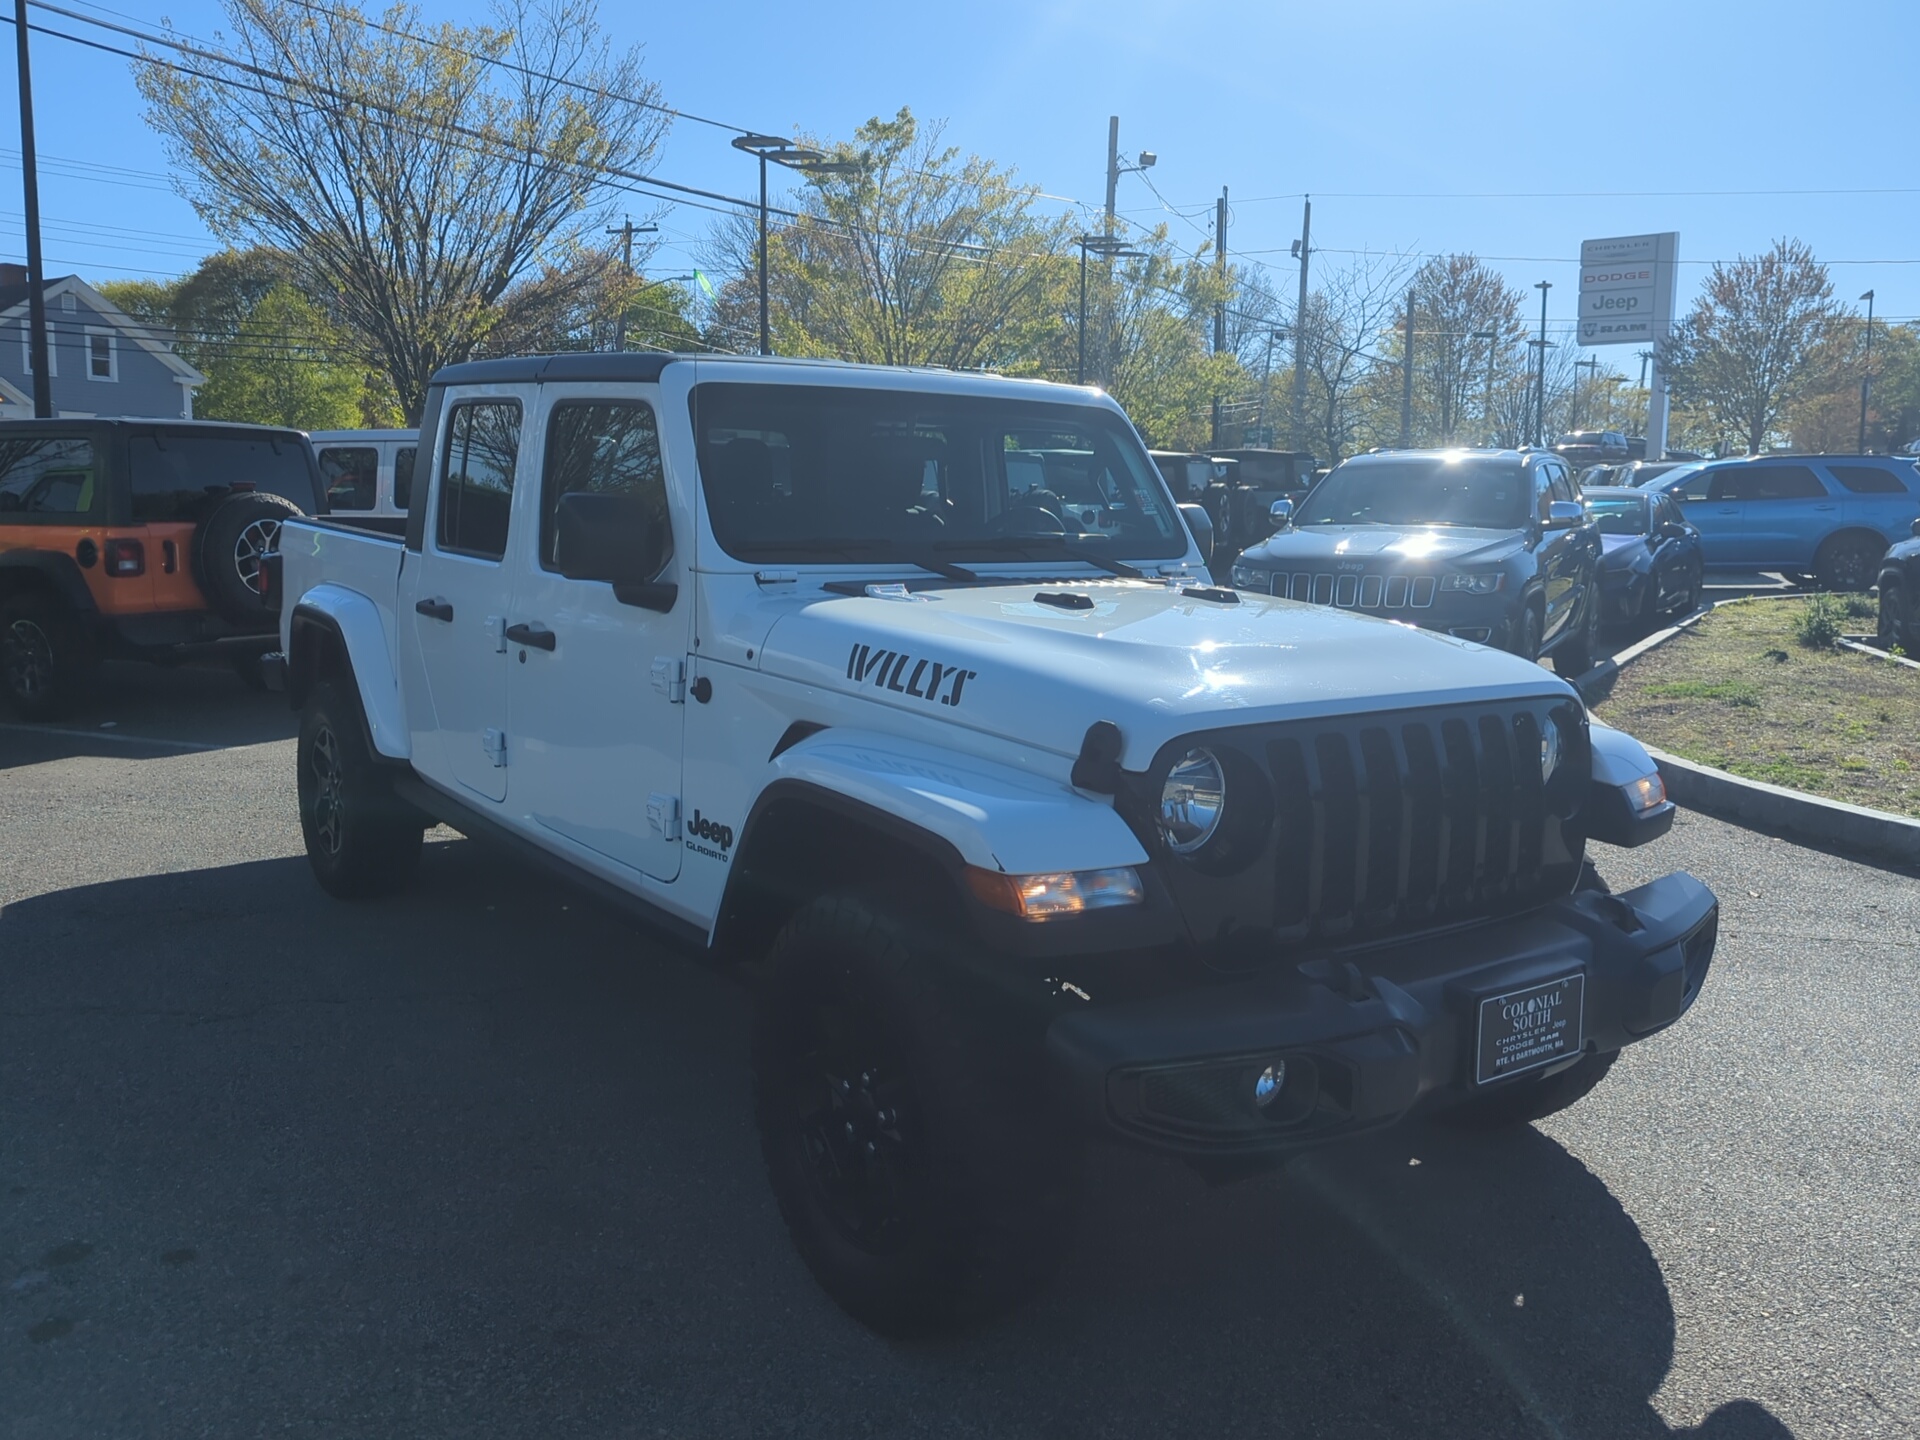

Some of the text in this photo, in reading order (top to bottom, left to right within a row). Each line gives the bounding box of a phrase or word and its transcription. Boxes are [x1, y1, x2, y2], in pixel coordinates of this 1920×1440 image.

[1587, 241, 1649, 252] CHRYSLER
[1584, 271, 1650, 284] DODGE
[1592, 295, 1638, 311] Jeep
[1600, 323, 1647, 333] RAM
[1337, 561, 1364, 572] Jeep
[847, 643, 977, 706] WILLYS
[687, 808, 733, 852] Jeep
[1502, 991, 1562, 1020] COLONIAL
[1512, 1008, 1551, 1032] SOUTH
[1495, 1026, 1546, 1046] CHRYSLER
[1502, 1032, 1559, 1054] DODGE RAM
[1555, 1039, 1564, 1048] MA
